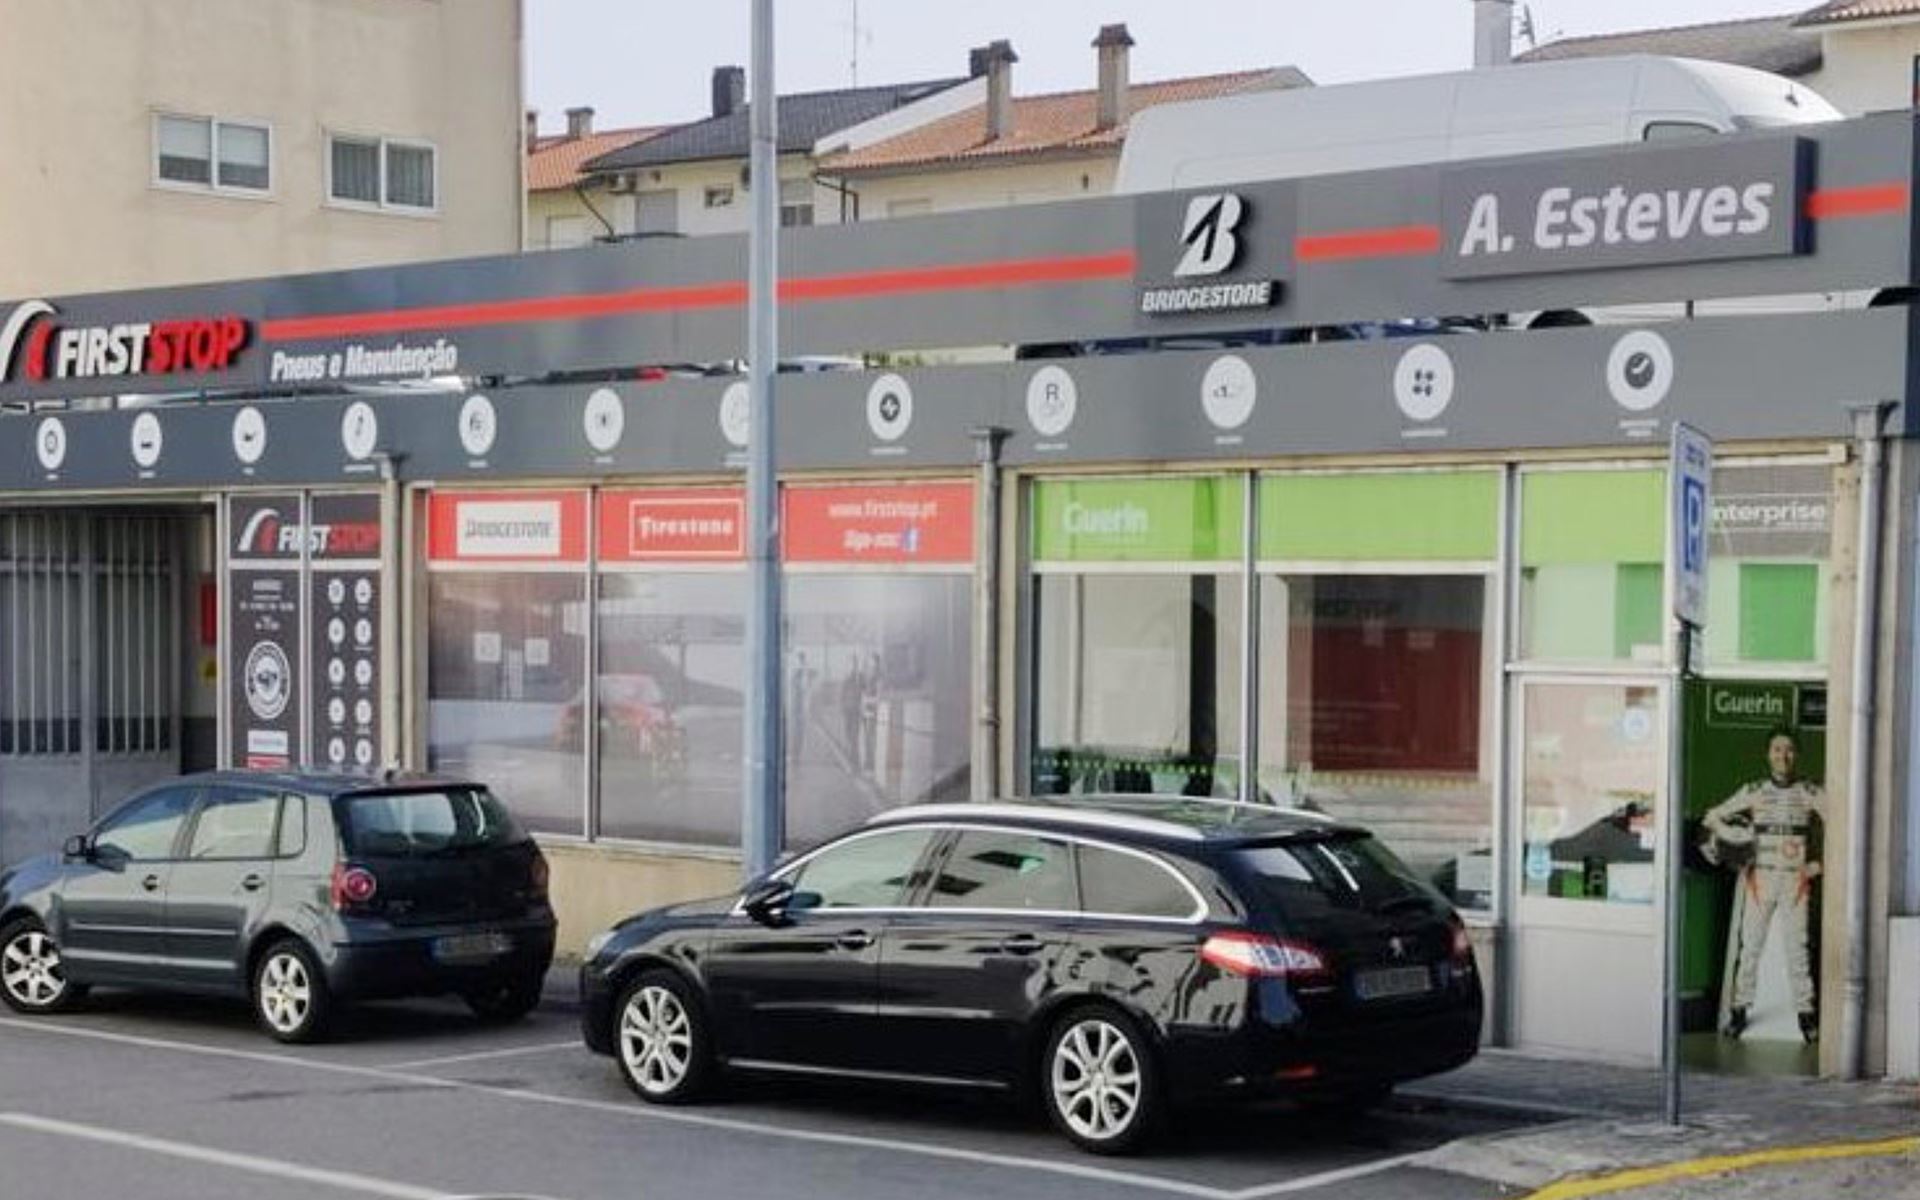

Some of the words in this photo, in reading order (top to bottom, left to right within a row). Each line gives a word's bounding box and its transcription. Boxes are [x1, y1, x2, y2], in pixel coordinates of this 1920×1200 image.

[1459, 194, 1514, 255] A.
[1534, 182, 1774, 249] Esteves
[1142, 281, 1269, 312] BRIDGESTONE
[270, 352, 326, 382] Pneus
[329, 354, 343, 378] e
[344, 338, 458, 380] Manutenção
[638, 515, 733, 541] Firestone
[1063, 501, 1149, 534] Guerin
[1712, 502, 1825, 525] nterprise
[1714, 690, 1784, 715] Guerin
